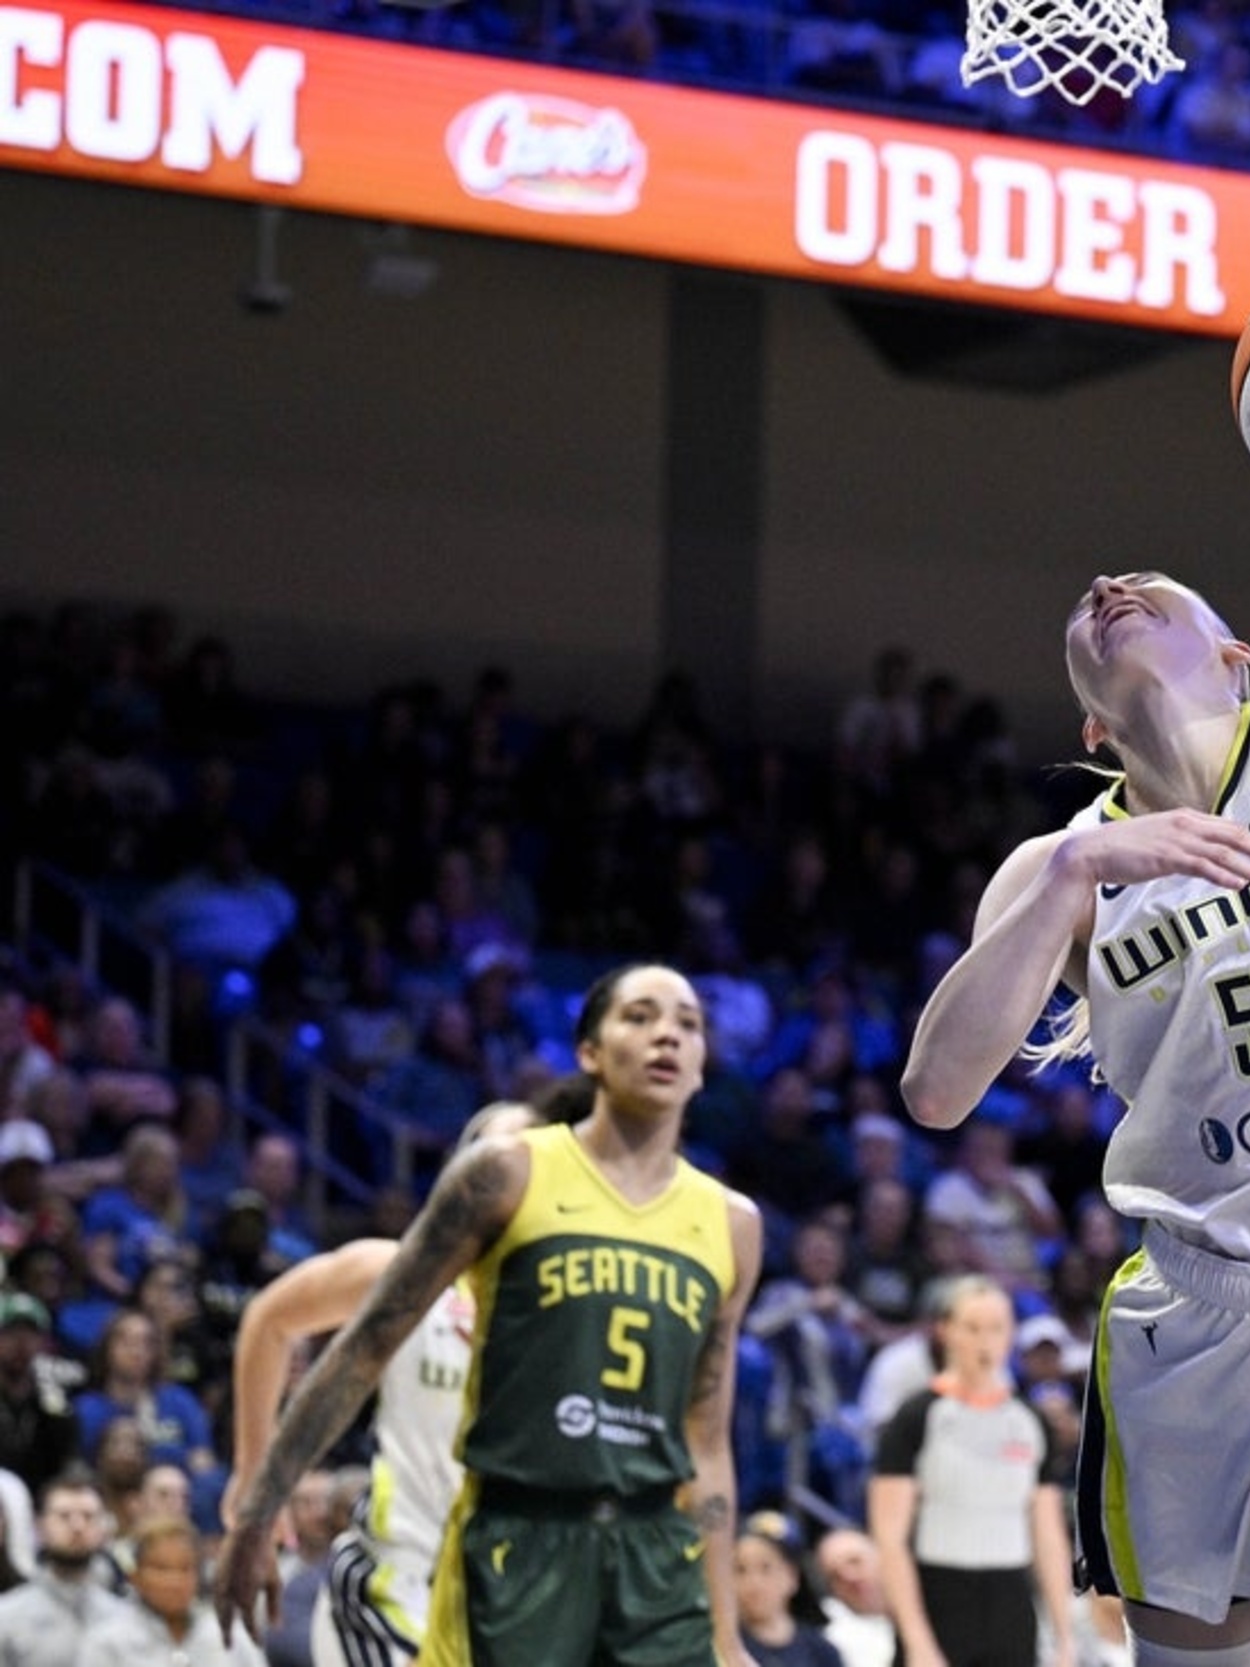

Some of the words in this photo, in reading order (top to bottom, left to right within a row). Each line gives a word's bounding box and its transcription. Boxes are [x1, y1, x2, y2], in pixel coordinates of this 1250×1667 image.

[0, 6, 304, 186] COM
[794, 130, 1224, 316] ORDER
[538, 1247, 707, 1333] SEATTLE
[602, 1306, 651, 1391] 5
